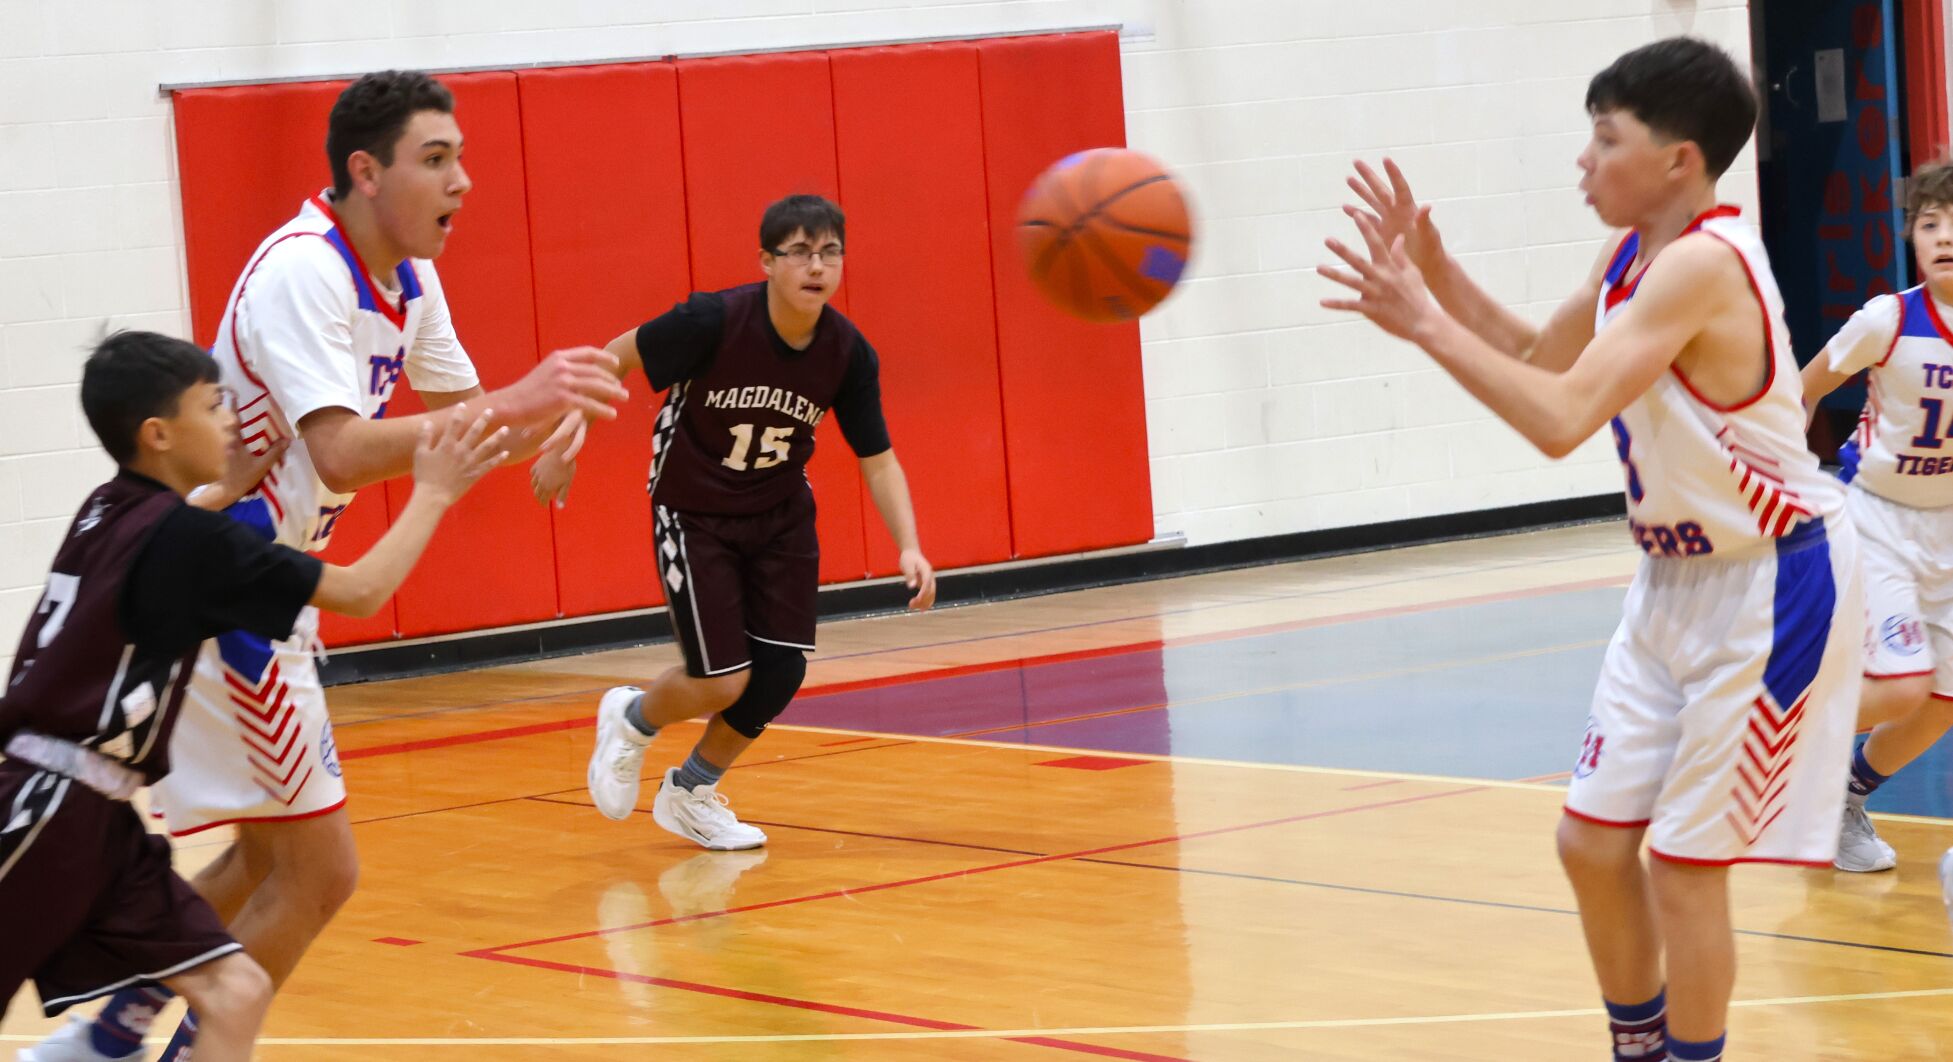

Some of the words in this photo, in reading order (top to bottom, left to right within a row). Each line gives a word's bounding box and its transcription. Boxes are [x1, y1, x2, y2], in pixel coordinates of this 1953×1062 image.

[721, 423, 795, 471] 15
[1911, 397, 1953, 449] 1
[1895, 453, 1953, 476] TIGE
